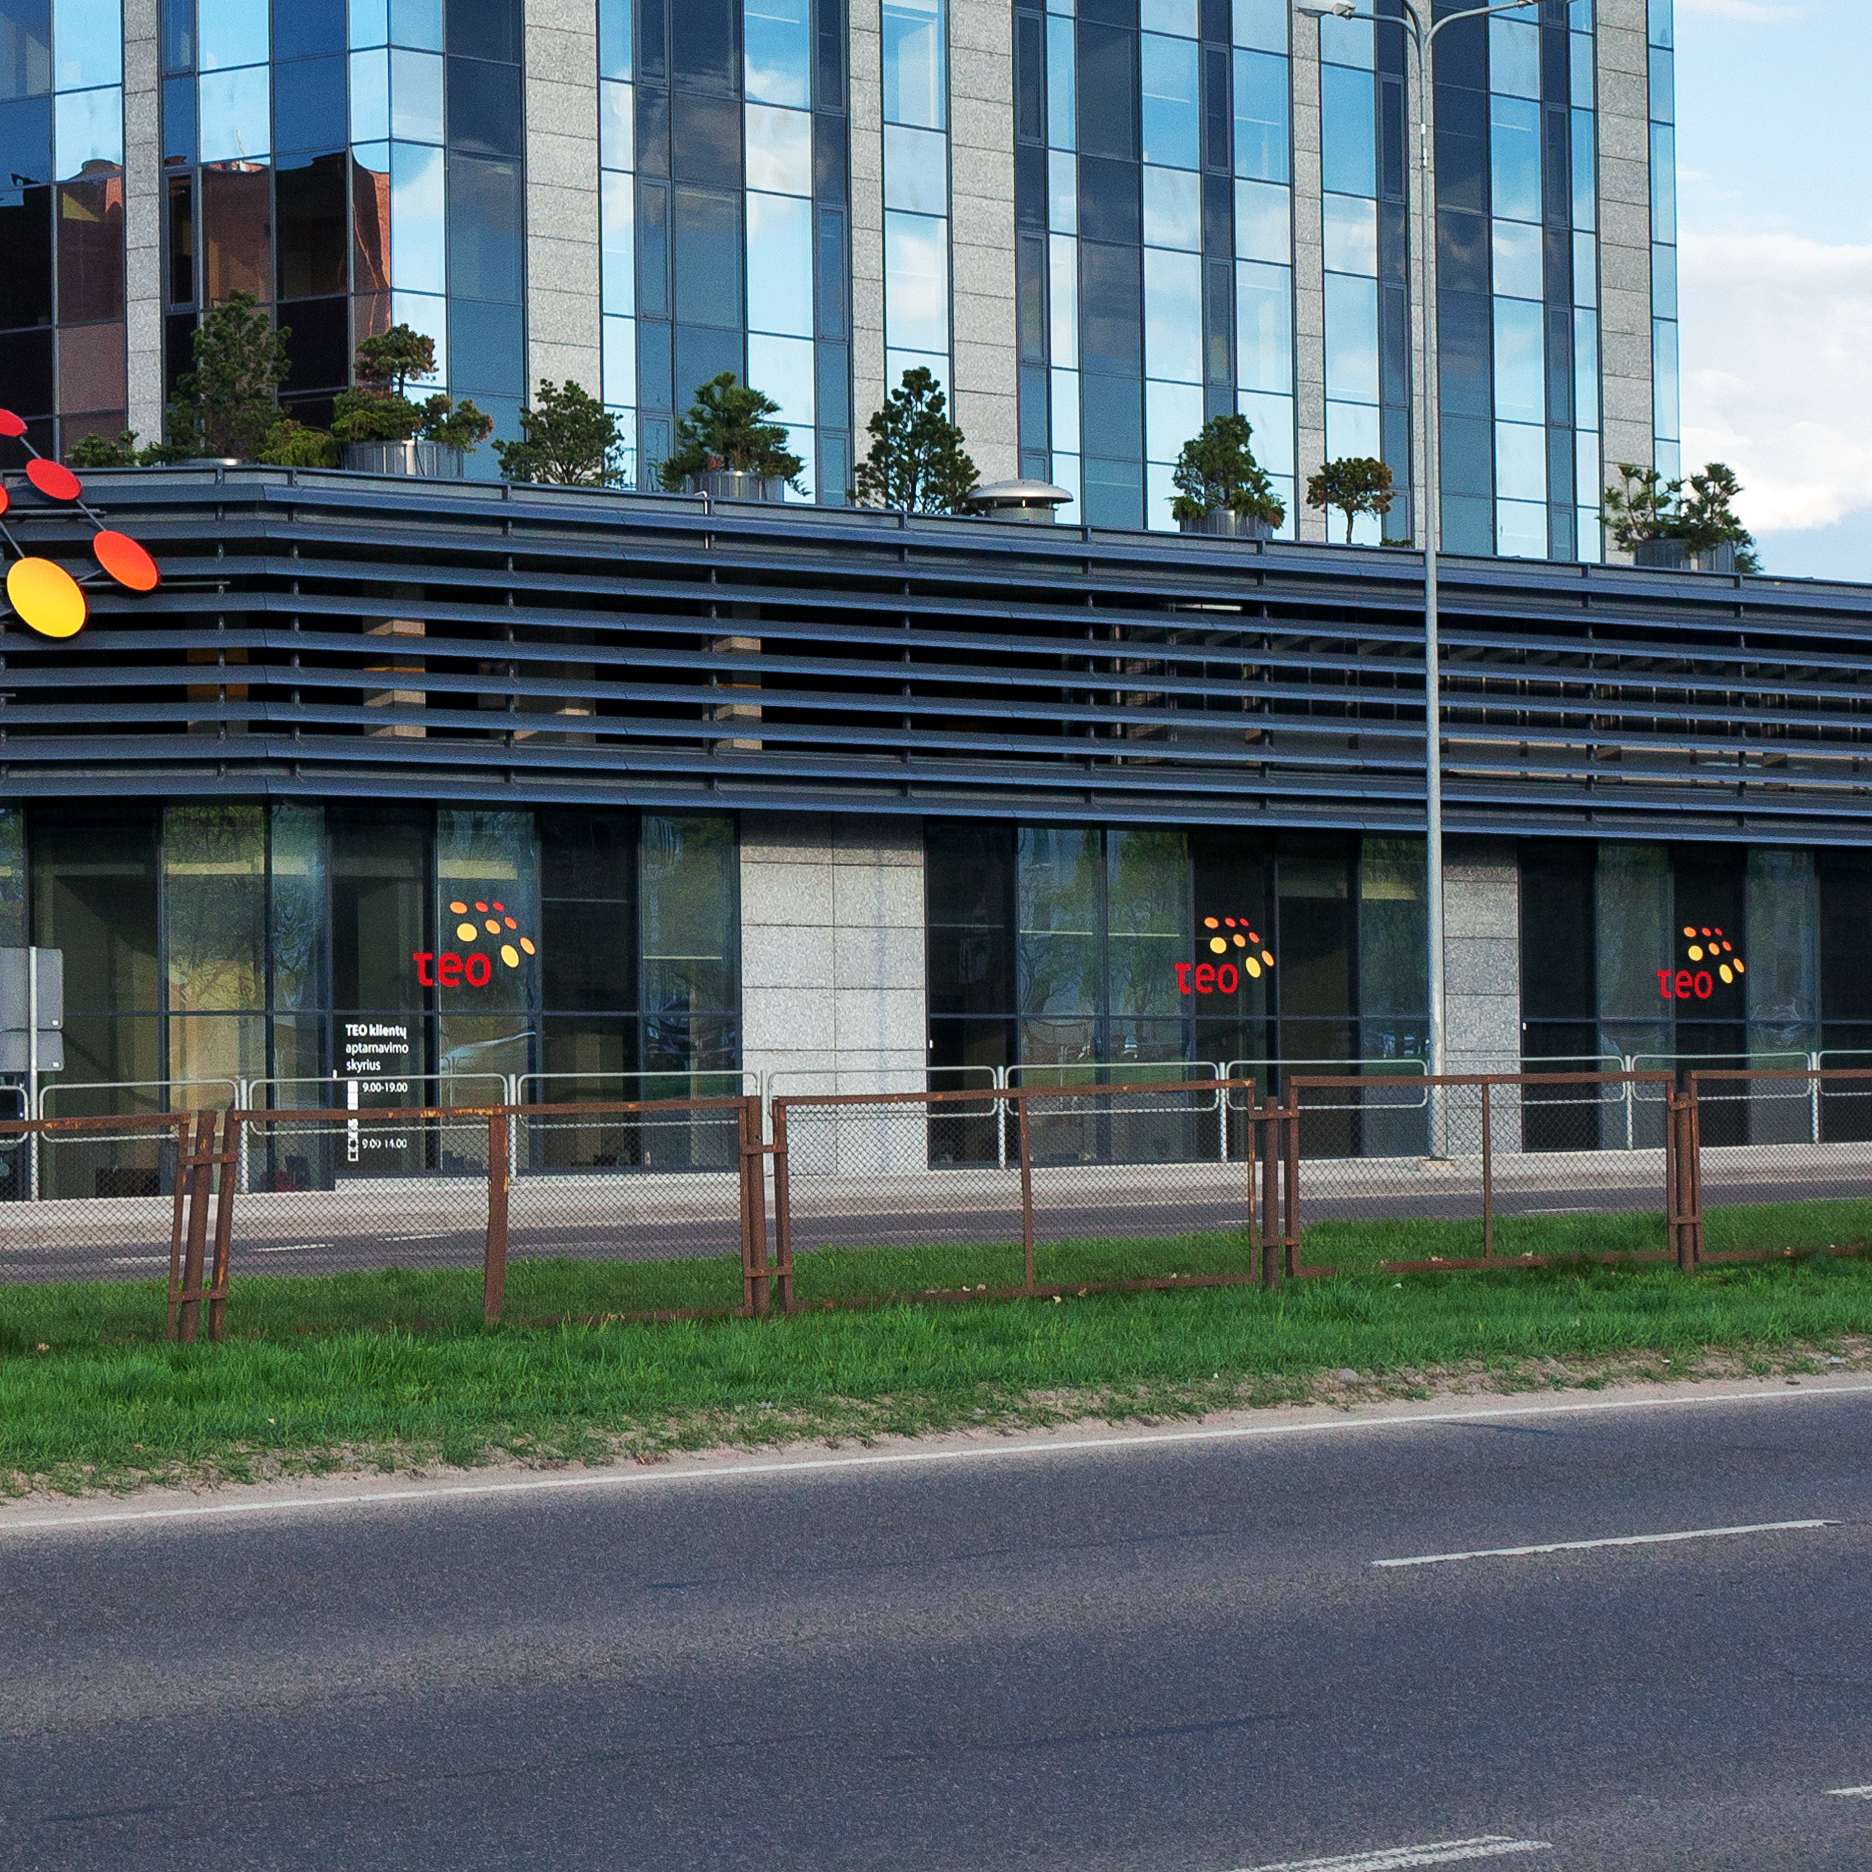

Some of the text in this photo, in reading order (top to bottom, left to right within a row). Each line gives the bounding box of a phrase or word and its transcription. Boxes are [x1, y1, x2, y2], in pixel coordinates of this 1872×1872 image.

[413, 952, 491, 987] teo
[1175, 963, 1238, 994] teo
[1657, 970, 1713, 999] teo
[345, 1024, 407, 1039] TEO klientų
[345, 1042, 409, 1056] aptarnavimo
[346, 1058, 381, 1073] skyrius
[362, 1082, 408, 1093] 9.00-19.00
